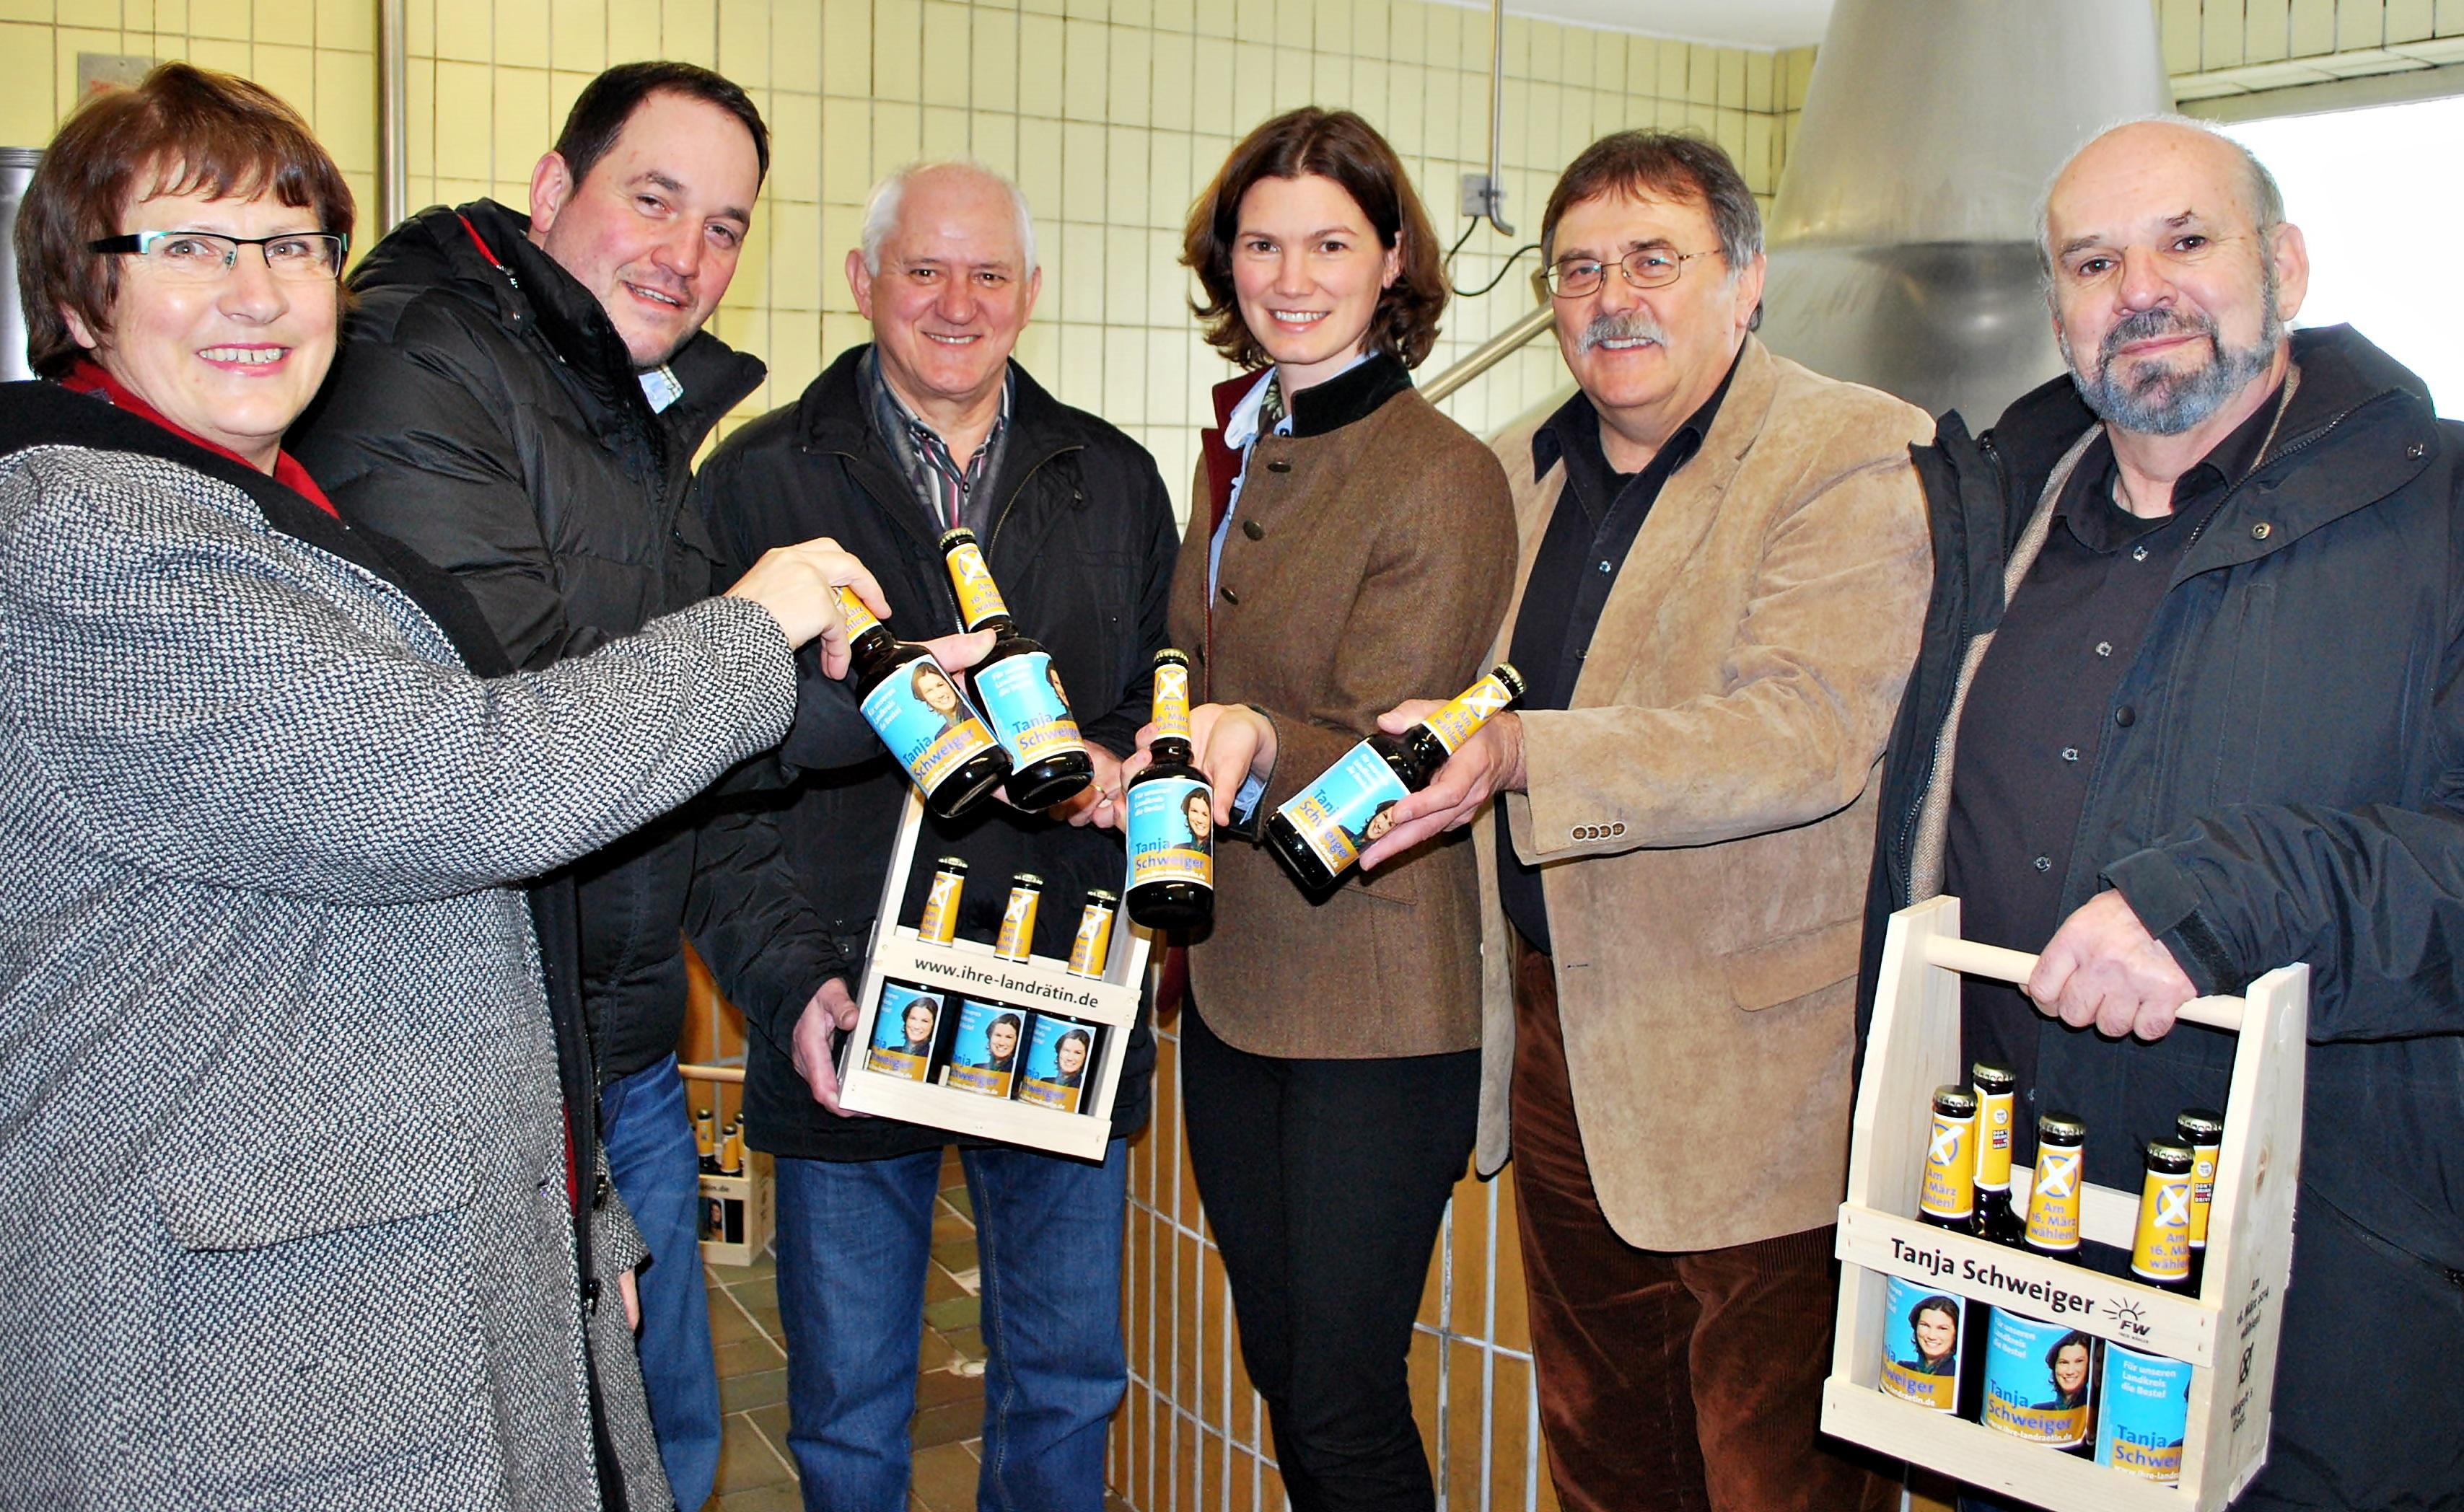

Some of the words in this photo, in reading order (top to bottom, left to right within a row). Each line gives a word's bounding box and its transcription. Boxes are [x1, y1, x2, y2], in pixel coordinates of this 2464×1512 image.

[1012, 712, 1053, 734] Tanja
[902, 736, 933, 766] Tanja
[913, 726, 975, 781] Schweiger
[1135, 838, 1170, 854] Tanja
[1136, 854, 1204, 871] Schweiger
[915, 958, 1098, 1008] www.ihre-landrätin.de
[953, 1053, 971, 1066] anja
[1929, 1181, 1957, 1197] März
[2043, 1202, 2064, 1213] Am
[2048, 1216, 2076, 1227] März
[2030, 1226, 2076, 1240] wählen!
[2166, 1234, 2185, 1243] Am
[2150, 1246, 2167, 1256] 16.
[1891, 1238, 1955, 1276] Tanja
[1963, 1259, 2095, 1314] Schweiger
[2120, 1320, 2151, 1336] FW
[2123, 1360, 2139, 1372] Für
[2139, 1366, 2178, 1379] unseren
[2122, 1371, 2167, 1389] Landkreis
[1989, 1379, 2029, 1409] Tanja
[2121, 1382, 2136, 1394] die
[2136, 1386, 2167, 1399] Beste!
[1989, 1398, 2074, 1437] Schweiger
[2116, 1424, 2168, 1451] Tanja
[2115, 1445, 2180, 1469] Schwei
